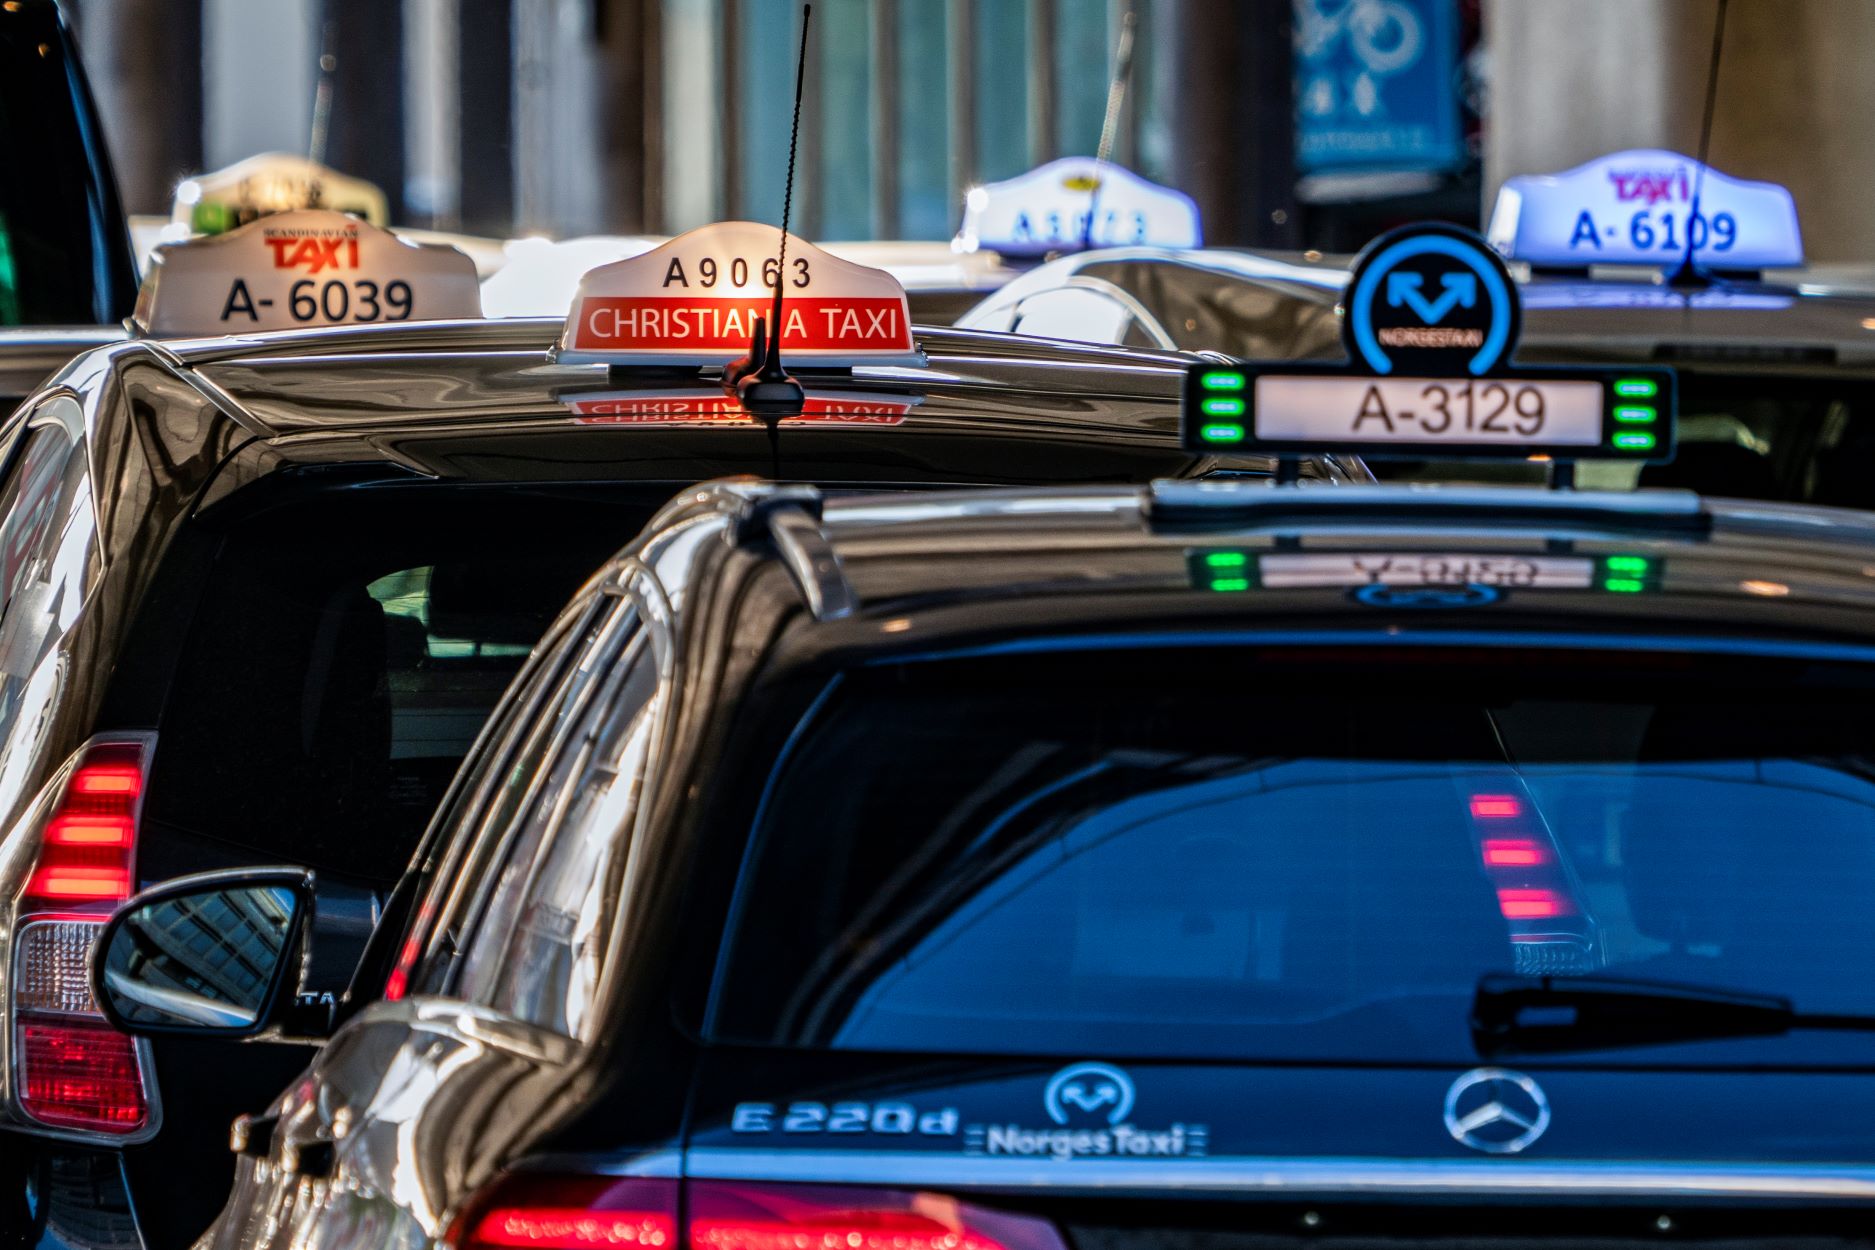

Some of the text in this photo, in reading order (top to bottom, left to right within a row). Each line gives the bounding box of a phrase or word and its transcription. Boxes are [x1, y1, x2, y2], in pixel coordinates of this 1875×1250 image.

[1630, 211, 1737, 251] 6109
[289, 278, 413, 322] 6039
[589, 308, 897, 339] CHRISTIANA TAXI
[1352, 379, 1546, 437] A-3129
[731, 1102, 960, 1135] E 220d
